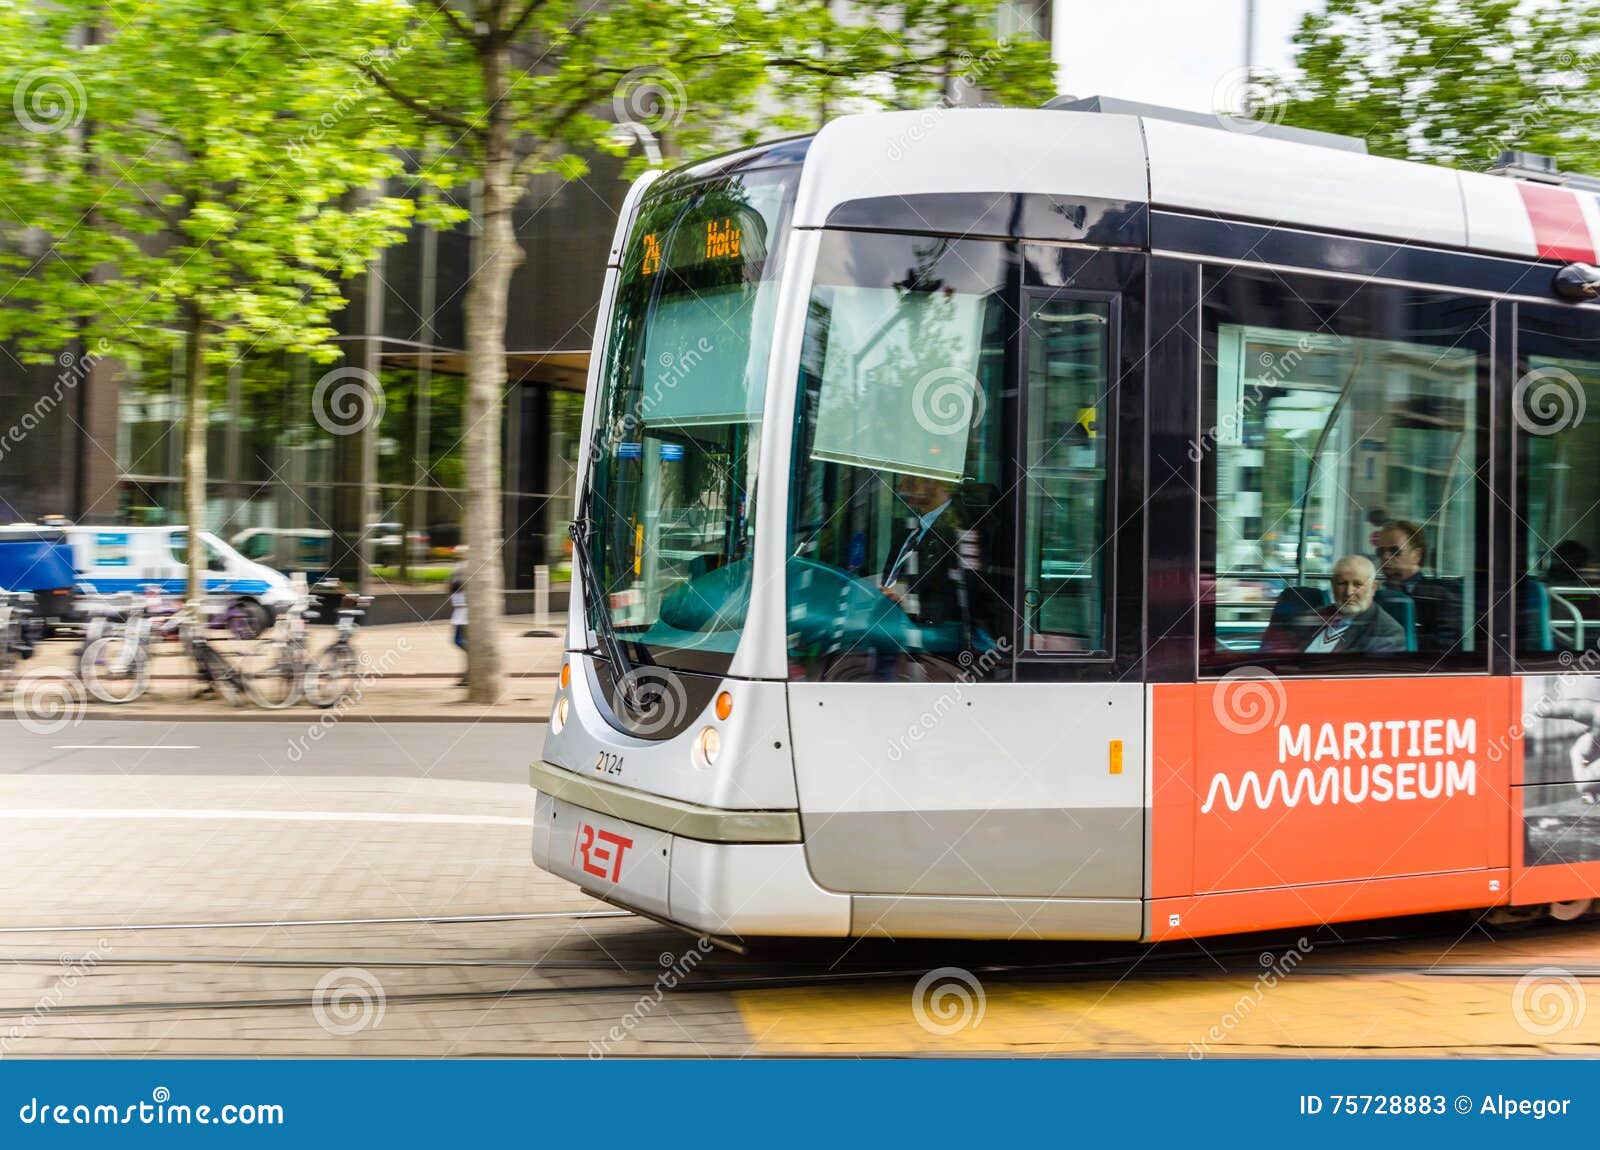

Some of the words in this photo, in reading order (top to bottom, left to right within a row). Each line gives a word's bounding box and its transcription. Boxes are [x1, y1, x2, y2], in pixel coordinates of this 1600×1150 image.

[642, 233, 661, 275] 24
[706, 218, 740, 258] Holy
[595, 750, 624, 776] 2124
[1278, 718, 1477, 763] MARITIEM
[1200, 759, 1477, 814] MUSEUM
[572, 821, 634, 883] RET
